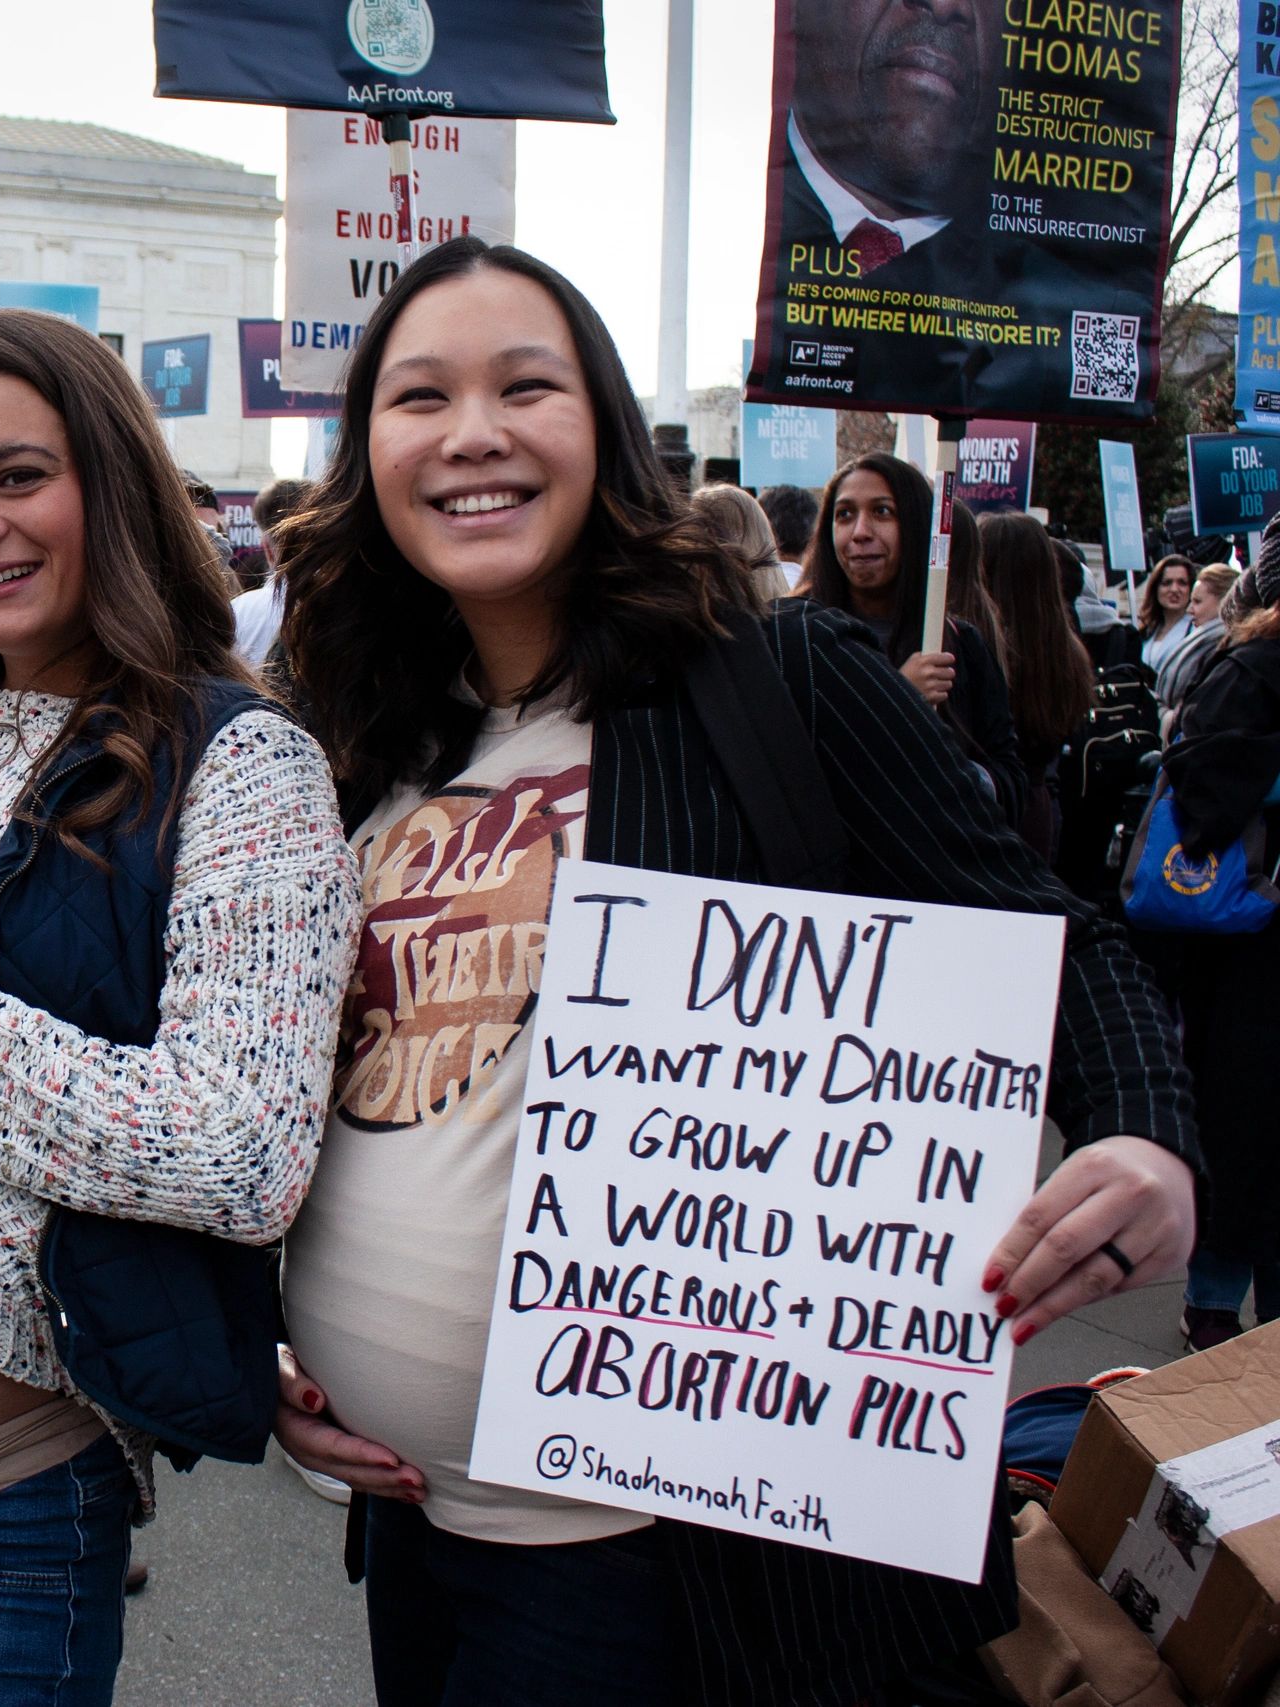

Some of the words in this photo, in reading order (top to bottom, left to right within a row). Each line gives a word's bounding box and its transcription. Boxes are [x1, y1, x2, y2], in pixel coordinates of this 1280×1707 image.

[1005, 0, 1162, 46] CLARENCE
[1002, 34, 1141, 83] THOMAS
[347, 83, 455, 109] AAFront.org
[998, 87, 1034, 112] THE
[1039, 93, 1104, 119] STRICT
[344, 118, 459, 152] ENUGH
[996, 113, 1155, 150] DESTRUCTIONIST
[993, 147, 1133, 193] MARRIED
[990, 193, 1010, 212] TO
[1013, 196, 1043, 215] THE
[336, 209, 470, 243] ENOGH!
[989, 213, 1146, 243] GINNSURRECTIONIST
[790, 243, 862, 278] PLUS
[787, 281, 819, 298] HE'S
[822, 285, 880, 303] COMING
[882, 290, 910, 305] FOR
[913, 294, 940, 309] OUR
[941, 296, 968, 312] BIRTH
[969, 301, 1019, 319] CONTROL
[786, 302, 828, 326] BUT
[832, 306, 907, 332] WHERE
[910, 313, 954, 337] WILL
[956, 318, 974, 340] HE
[975, 322, 1032, 345] STORE
[1036, 326, 1061, 347] IT?
[821, 359, 841, 367] FRONT
[822, 344, 853, 353] ABORTION
[822, 352, 846, 360] ACCESS
[785, 374, 854, 393] aafront.org
[757, 418, 821, 439] MEDICAL
[771, 440, 808, 459] CARE
[958, 437, 1019, 461] WOMEN'S
[1232, 446, 1263, 470] FDA:
[962, 461, 1011, 484] HEALTH
[1221, 472, 1239, 494] DO
[1242, 469, 1278, 492] YOUR
[1240, 494, 1263, 517] JOB
[370, 914, 549, 1021] THEIR
[567, 893, 647, 1006] I
[687, 899, 912, 1027] DON'T
[544, 1036, 721, 1084] WANT
[735, 1046, 808, 1097] MY
[820, 1033, 1042, 1118] DAUGHTER
[527, 1101, 596, 1155] TO
[629, 1107, 791, 1174] GROW
[813, 1121, 892, 1188] UP
[918, 1136, 983, 1203] IN
[526, 1173, 568, 1237] A
[606, 1183, 793, 1262] WORLD
[817, 1213, 954, 1287] WITH
[509, 1250, 782, 1332] DANGEROUS
[828, 1296, 1002, 1363] DEADLY
[848, 1374, 966, 1460] PILLS
